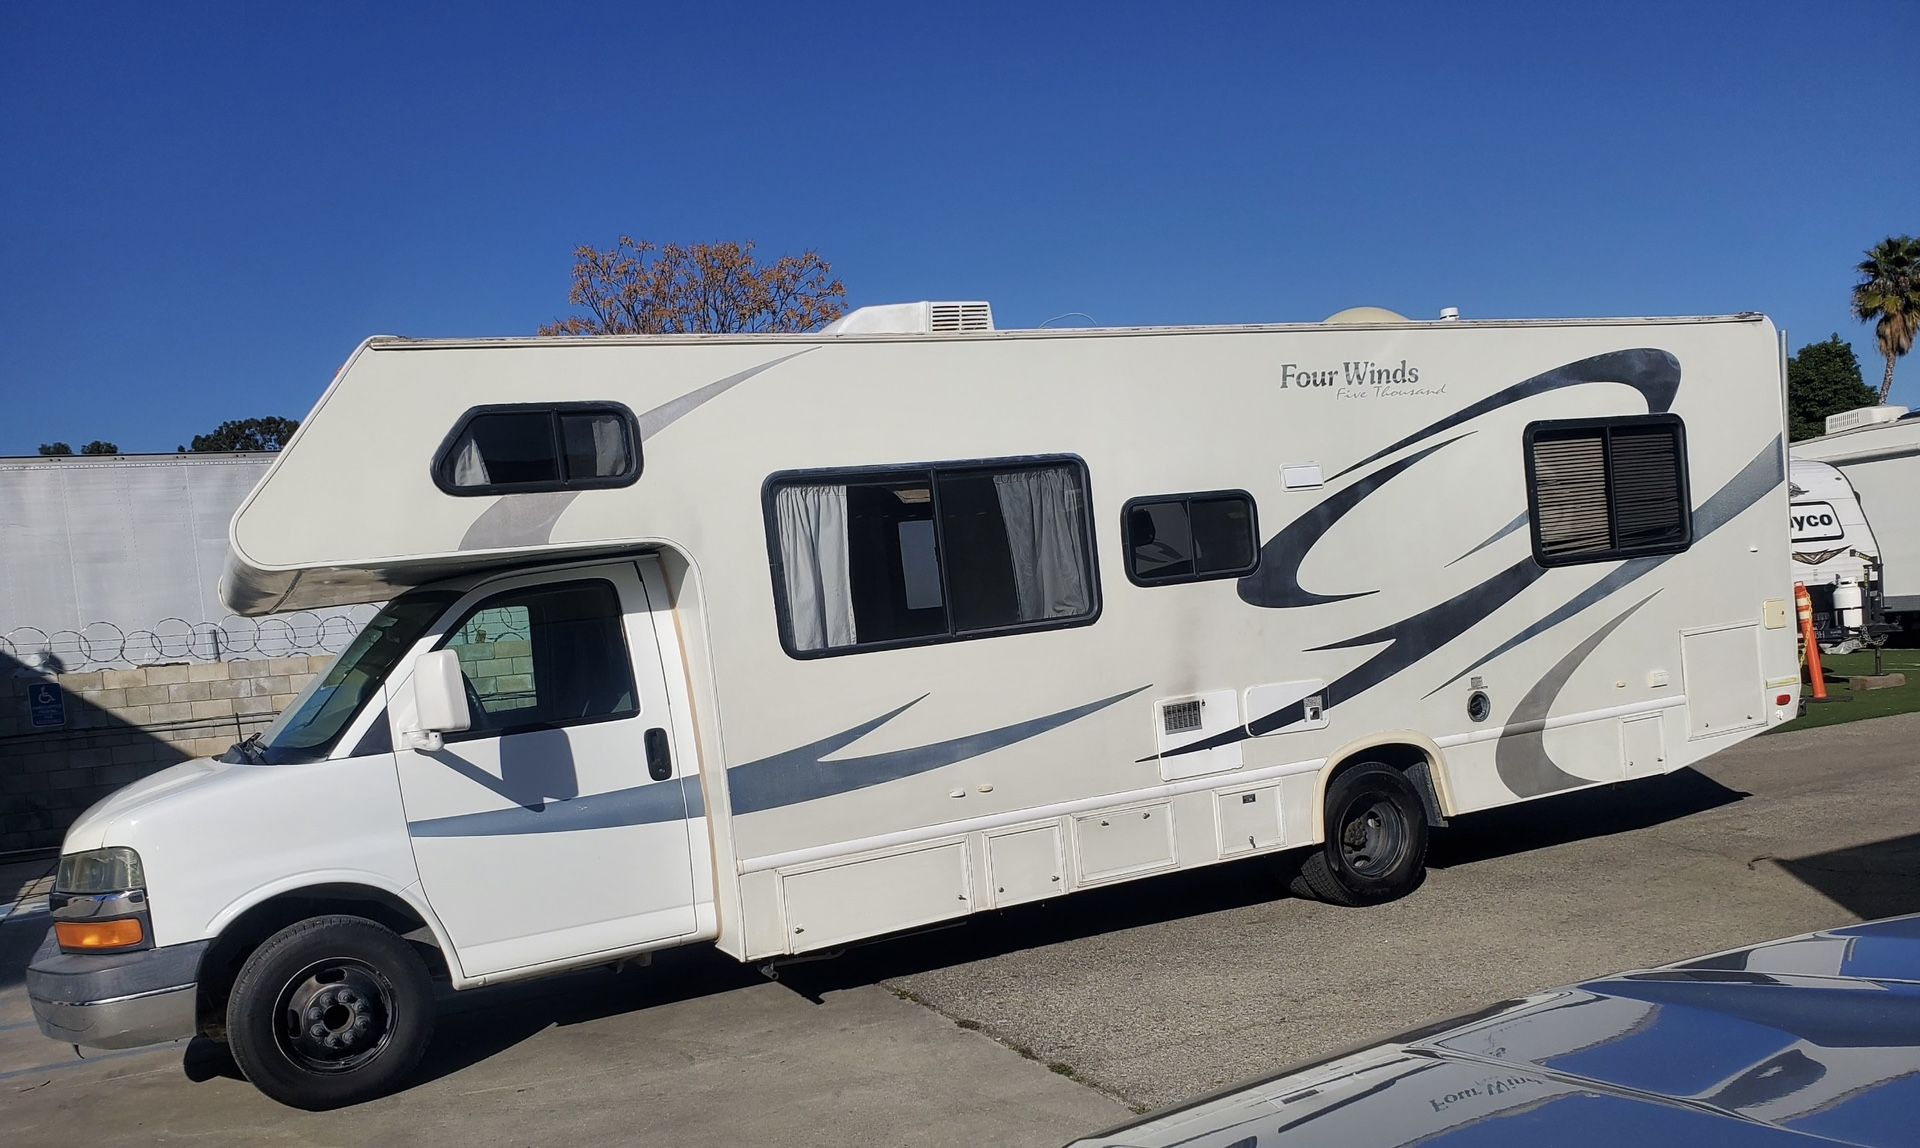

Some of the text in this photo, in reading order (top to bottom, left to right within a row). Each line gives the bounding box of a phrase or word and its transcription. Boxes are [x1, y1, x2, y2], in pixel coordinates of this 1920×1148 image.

[1280, 360, 1419, 388] Four Winds
[1336, 384, 1447, 400] Five Thousand
[1791, 514, 1833, 531] yco
